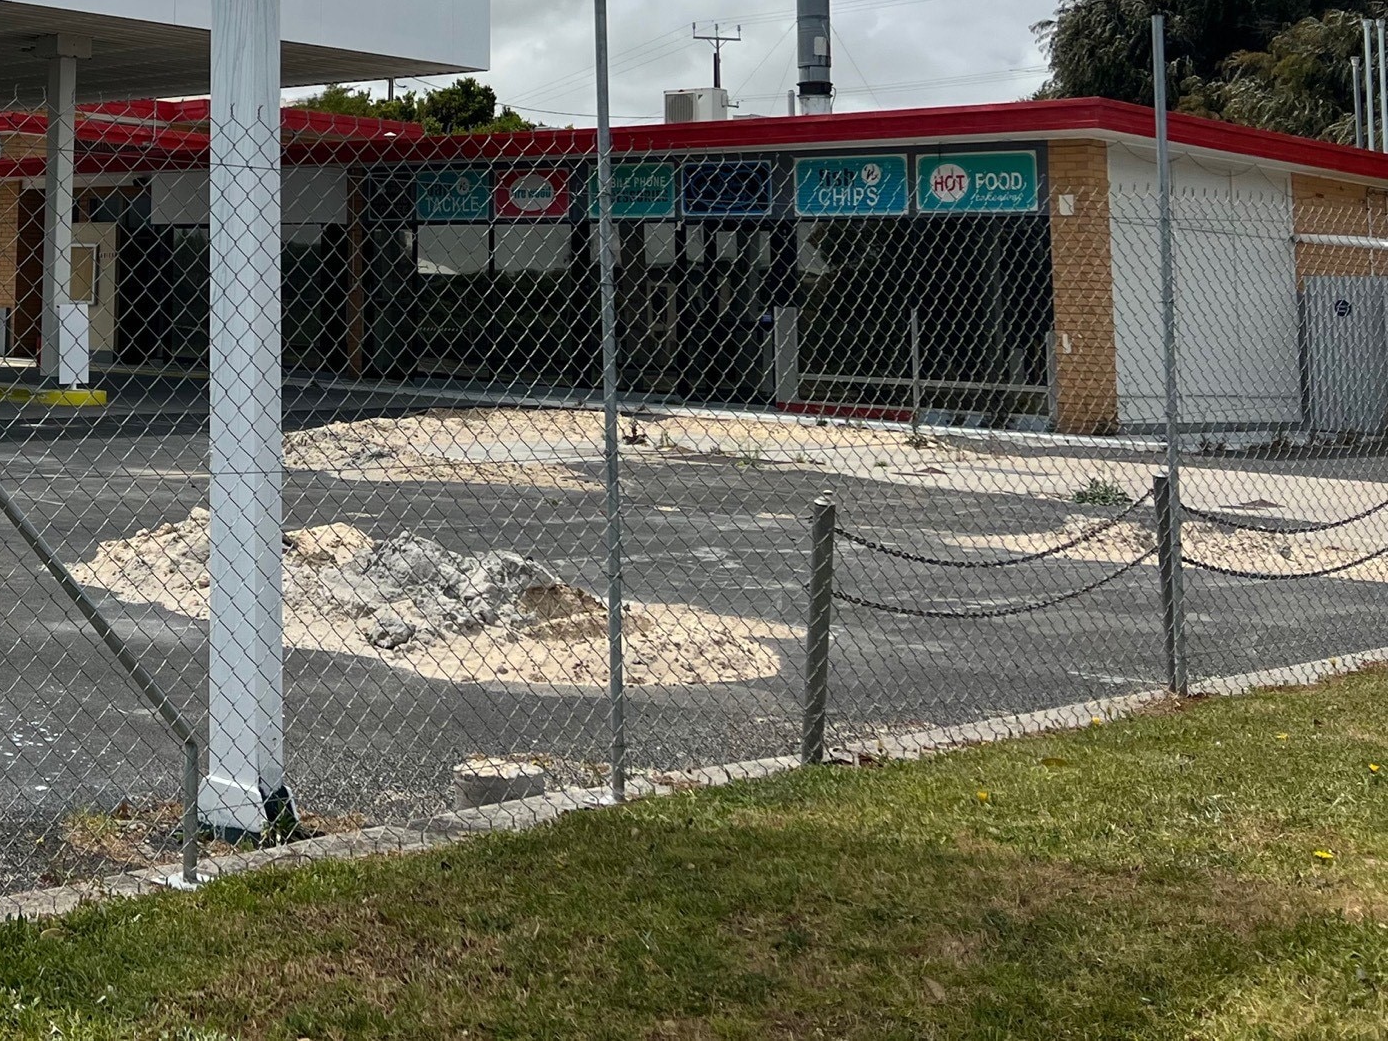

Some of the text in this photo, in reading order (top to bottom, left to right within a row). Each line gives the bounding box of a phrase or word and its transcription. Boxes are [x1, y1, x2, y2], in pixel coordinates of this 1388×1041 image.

[633, 176, 666, 188] PHONE
[818, 168, 855, 187] fish
[933, 172, 1023, 192] HOT FOOD
[425, 195, 479, 212] TACKLE
[818, 187, 880, 207] CHIPS
